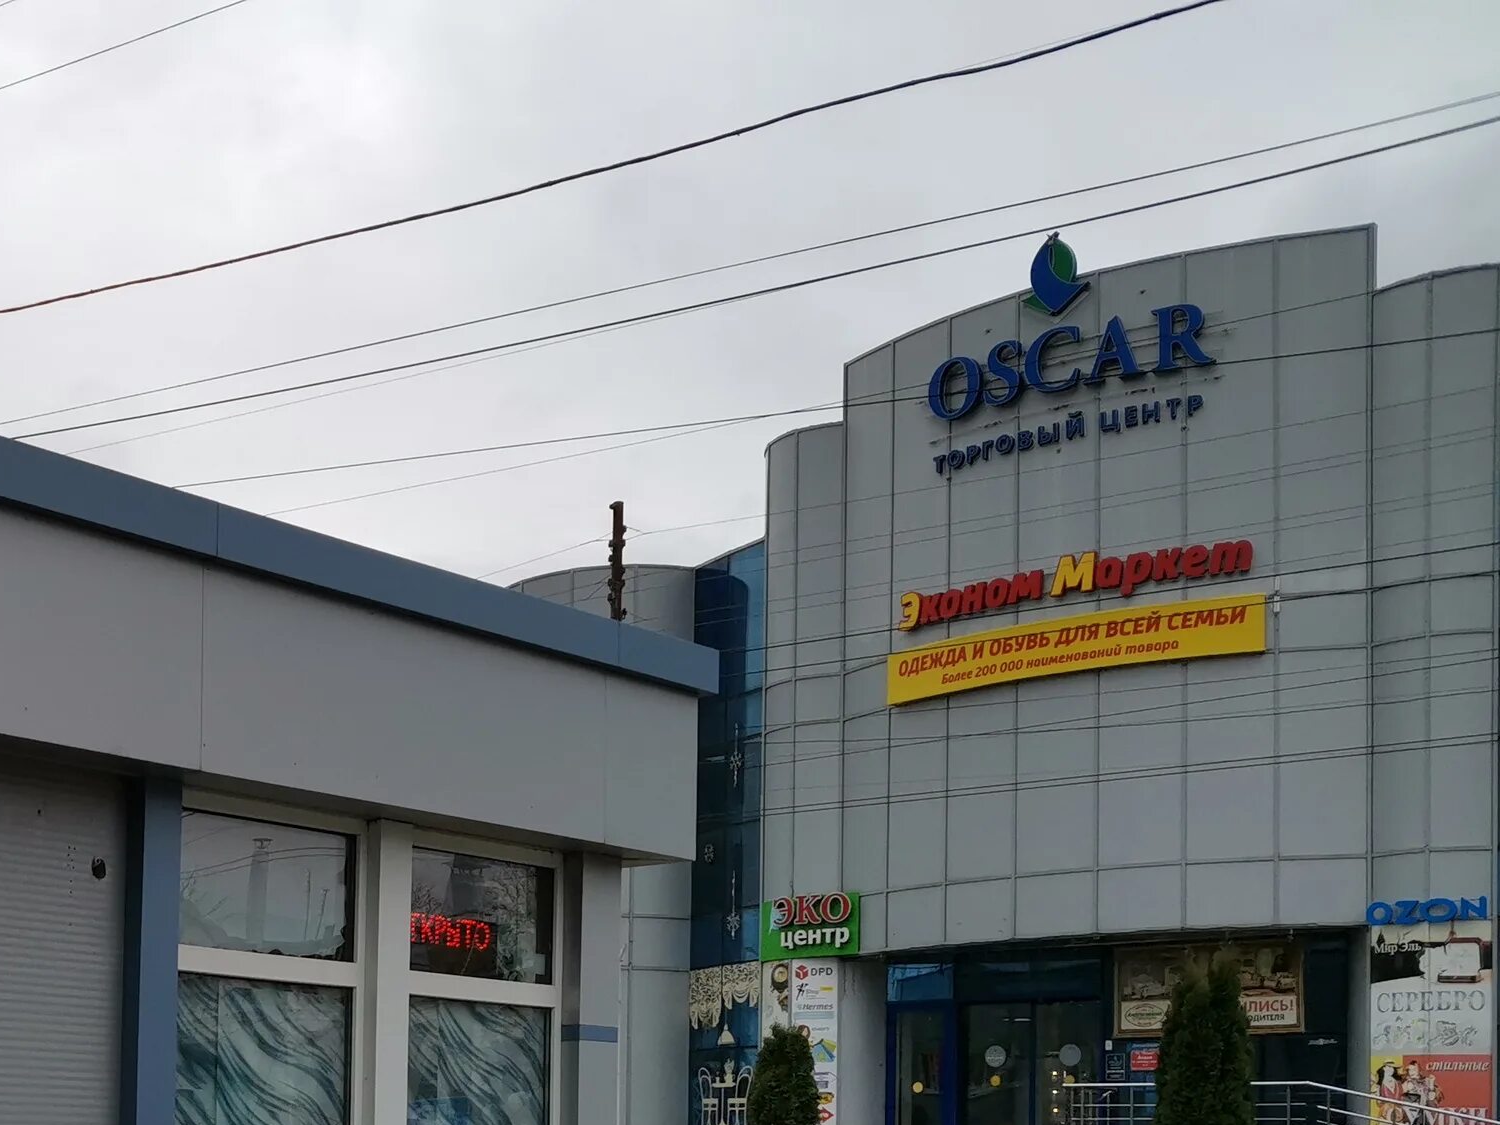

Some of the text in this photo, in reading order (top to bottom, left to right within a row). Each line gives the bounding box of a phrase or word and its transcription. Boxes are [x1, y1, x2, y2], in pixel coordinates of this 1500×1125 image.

[928, 303, 1216, 421] OSCAR
[933, 395, 1204, 474] ТОРГОВЫЙ ЦЕНТР
[899, 539, 1253, 632] Эконом Маркет
[898, 605, 1247, 677] ОДЕЖДА И ОБУВЬ ДЛЯ ВСЕЙ СЕМЬИ
[941, 639, 1179, 685] Более 200 000 наименований товара
[772, 892, 851, 927] ЭКО
[1366, 896, 1487, 926] OZON
[411, 912, 490, 952] ТКРЫТО
[780, 927, 850, 950] центр
[1374, 943, 1398, 955] Мир
[810, 967, 833, 976] DPD
[803, 1003, 834, 1011] Hermes
[1377, 990, 1485, 1013] СЕРЕБРО
[1247, 1013, 1285, 1023] ОДИТЕЛЯ
[1425, 1061, 1491, 1072] стильные
